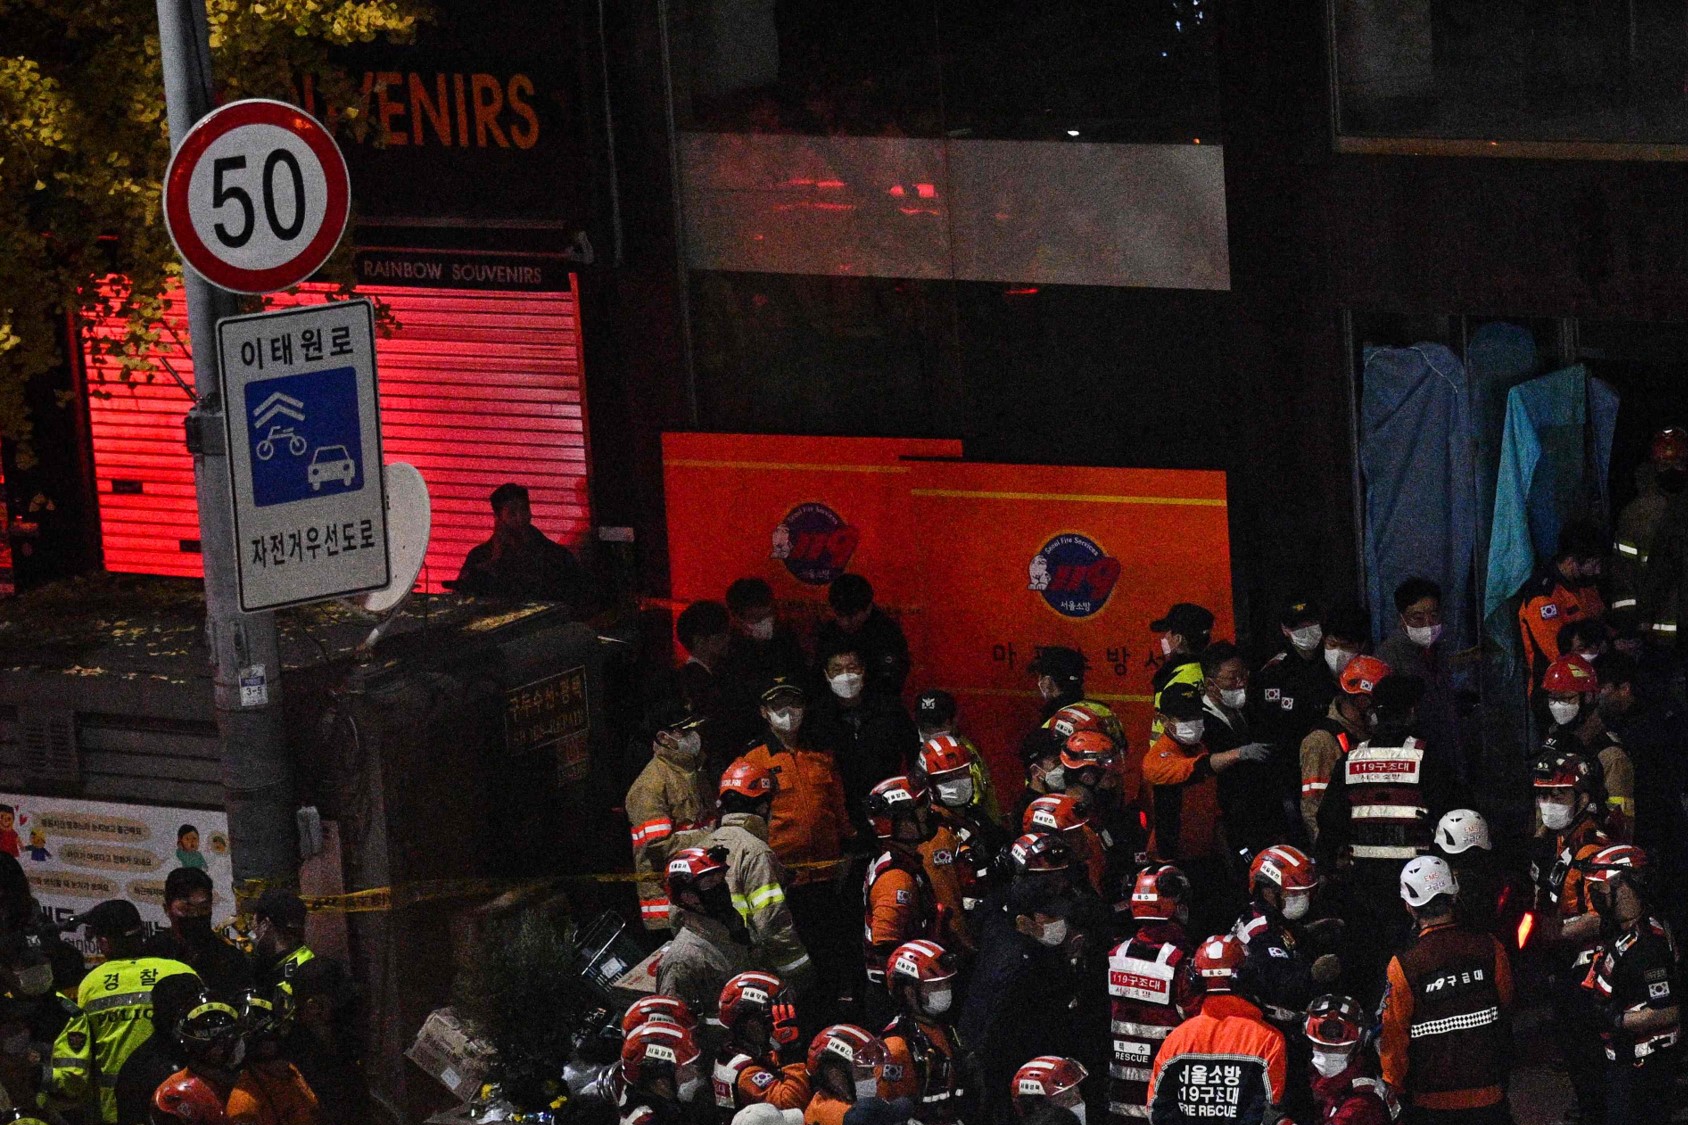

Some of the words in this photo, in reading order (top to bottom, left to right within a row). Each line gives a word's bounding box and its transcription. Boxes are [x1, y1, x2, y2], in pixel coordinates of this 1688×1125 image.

[212, 148, 305, 249] 50
[363, 260, 442, 281] RAINBOW
[452, 263, 542, 284] SOUVENIRS
[240, 326, 354, 369] 이태원로
[251, 519, 375, 568] 자전거우선도로
[1060, 600, 1091, 612] 서울소방
[1354, 762, 1410, 775] 119구조대
[103, 966, 160, 989] 경찰
[1112, 972, 1162, 992] 119구조대
[96, 1009, 156, 1024] POLIC
[1114, 1051, 1149, 1064] RESCUE
